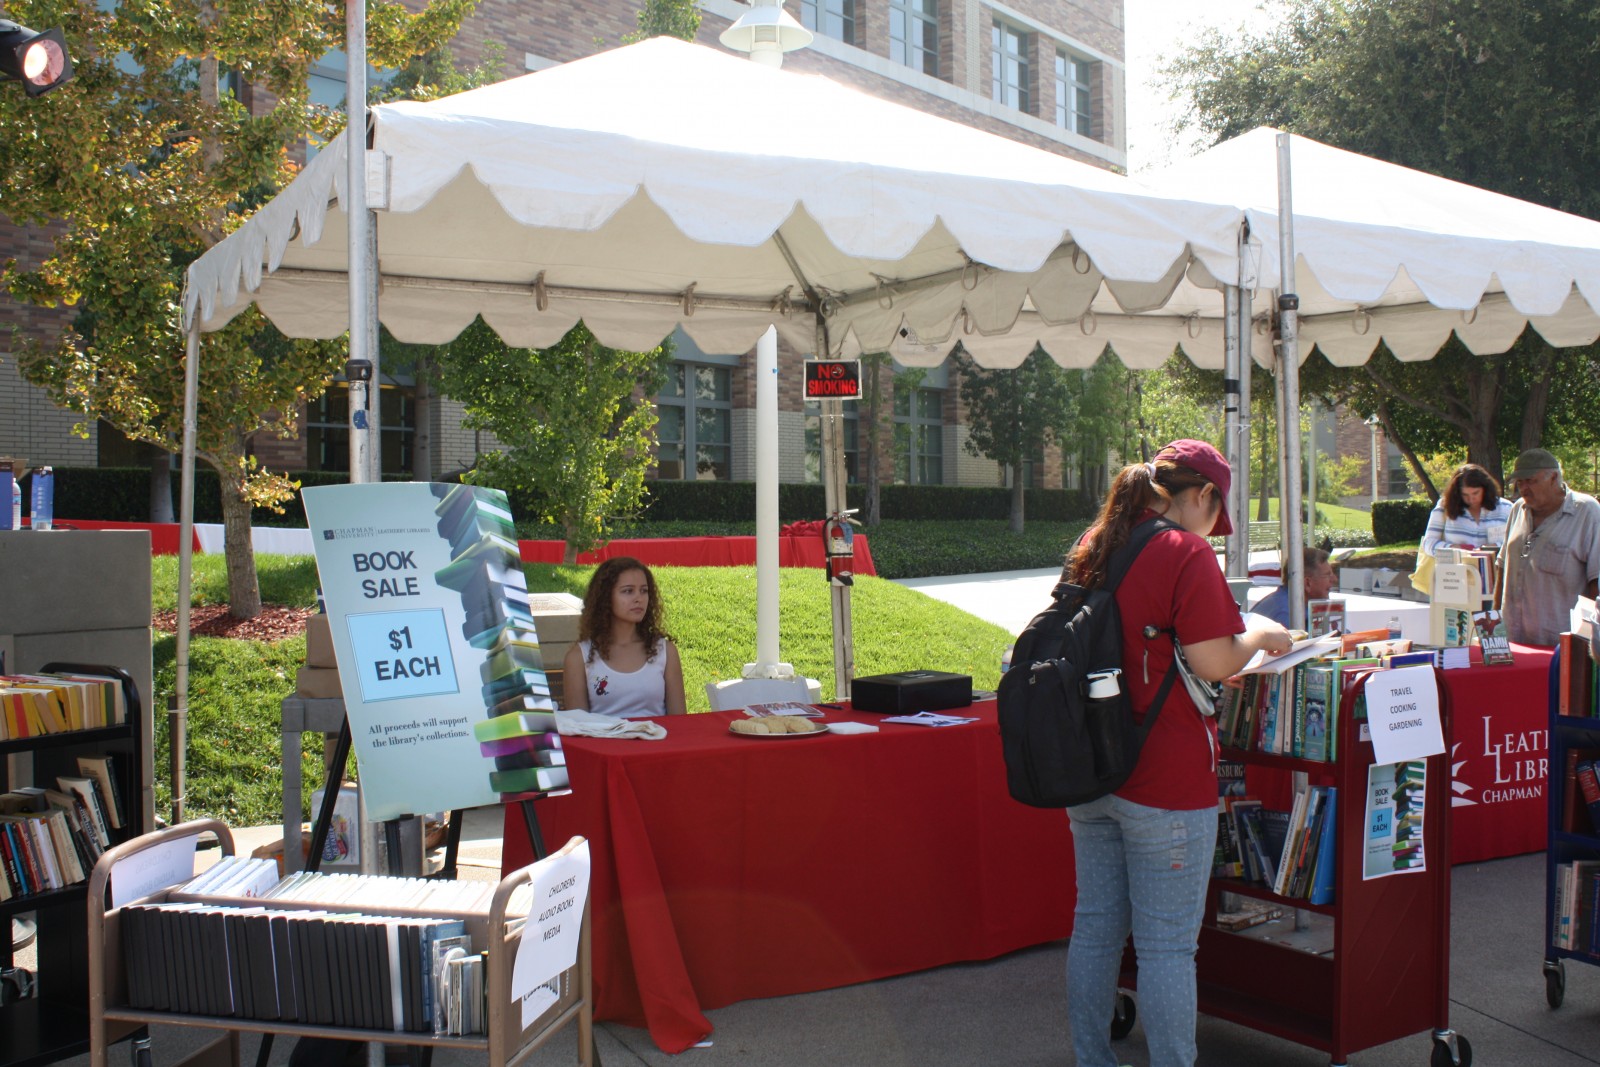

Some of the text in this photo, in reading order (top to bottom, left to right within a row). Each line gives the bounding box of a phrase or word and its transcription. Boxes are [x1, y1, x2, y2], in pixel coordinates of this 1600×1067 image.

[808, 379, 856, 395] SMOKING
[334, 526, 374, 534] CHAPMAN
[352, 551, 418, 572] BOOK
[362, 577, 420, 599] SALE
[388, 626, 412, 652] $1
[374, 656, 441, 681] EACH
[1390, 687, 1412, 696] TRAVEL
[1390, 703, 1416, 714] COOKING
[368, 716, 468, 735] All proceeds will support
[1295, 700, 1303, 742] GARDENING
[1389, 718, 1422, 731] GARDENING
[372, 730, 469, 748] the library's collections.
[1375, 788, 1388, 797] BOOK
[1482, 785, 1542, 804] CHAPMAN
[1373, 824, 1388, 832] EACH
[548, 875, 575, 896] CHILDRENS
[538, 897, 574, 923] AUDIO BOOKS
[543, 924, 561, 941] MEDIA
